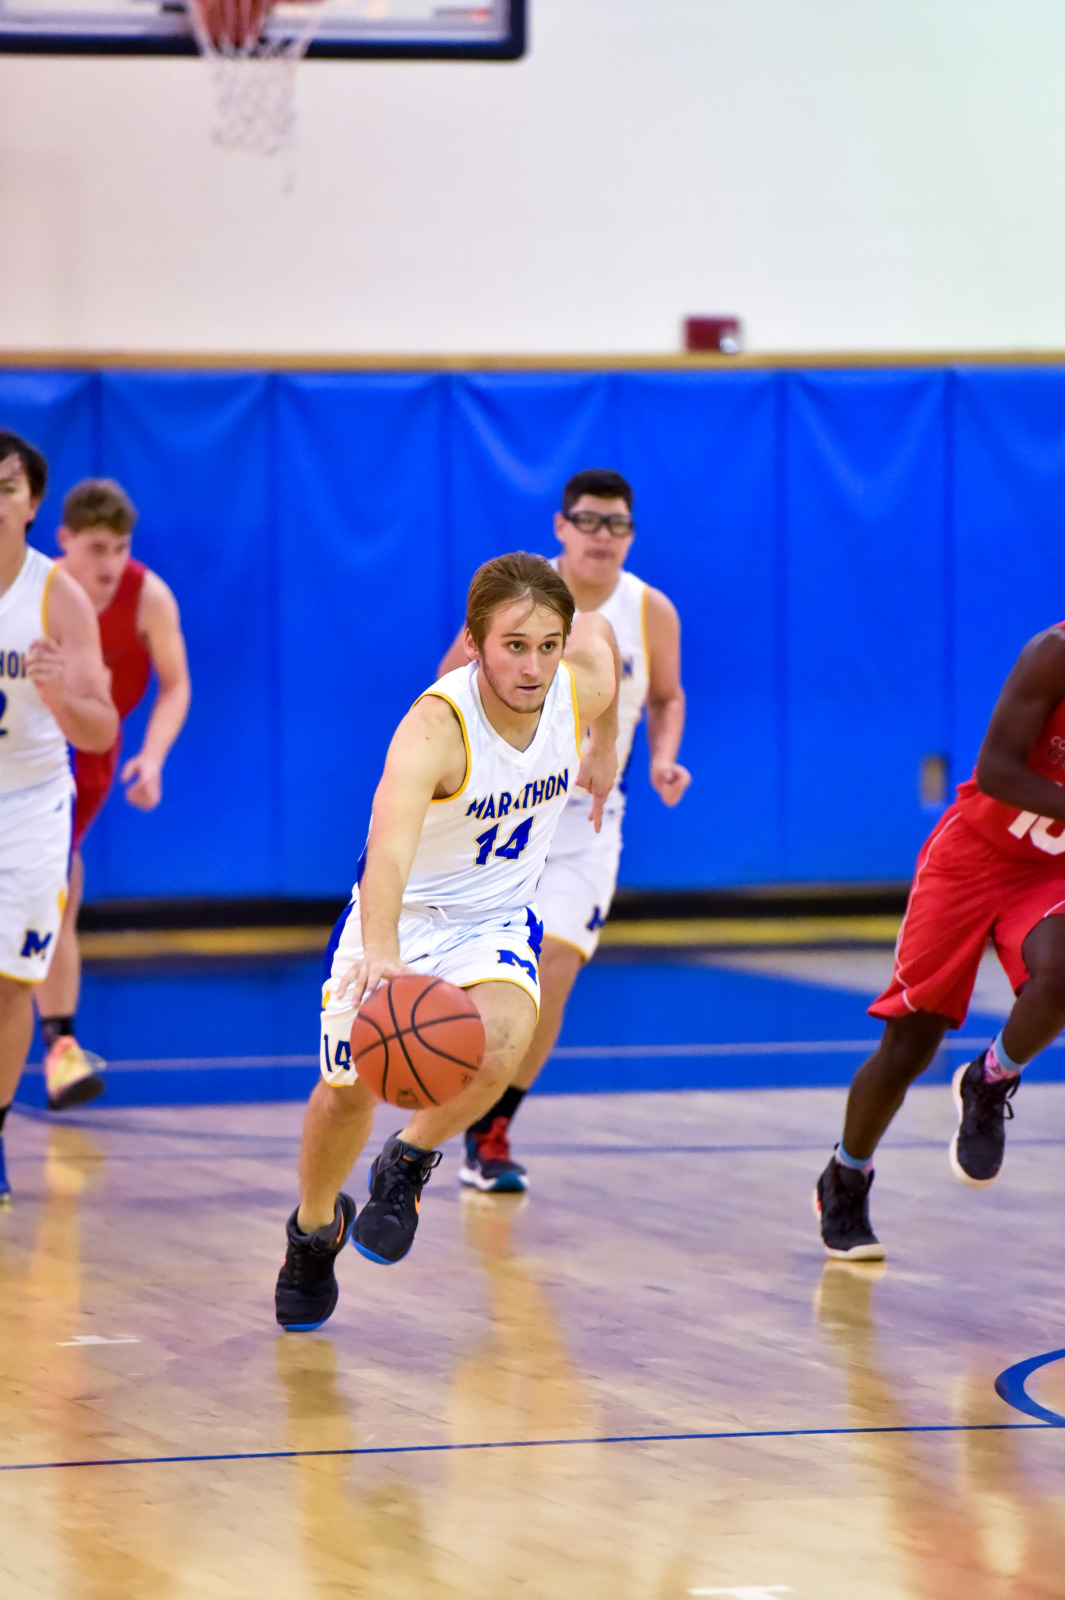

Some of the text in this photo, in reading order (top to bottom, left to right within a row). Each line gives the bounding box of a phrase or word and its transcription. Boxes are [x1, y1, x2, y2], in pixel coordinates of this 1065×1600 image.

[465, 767, 569, 820] MARATHON
[473, 815, 536, 867] 14
[324, 1033, 352, 1073] 14
